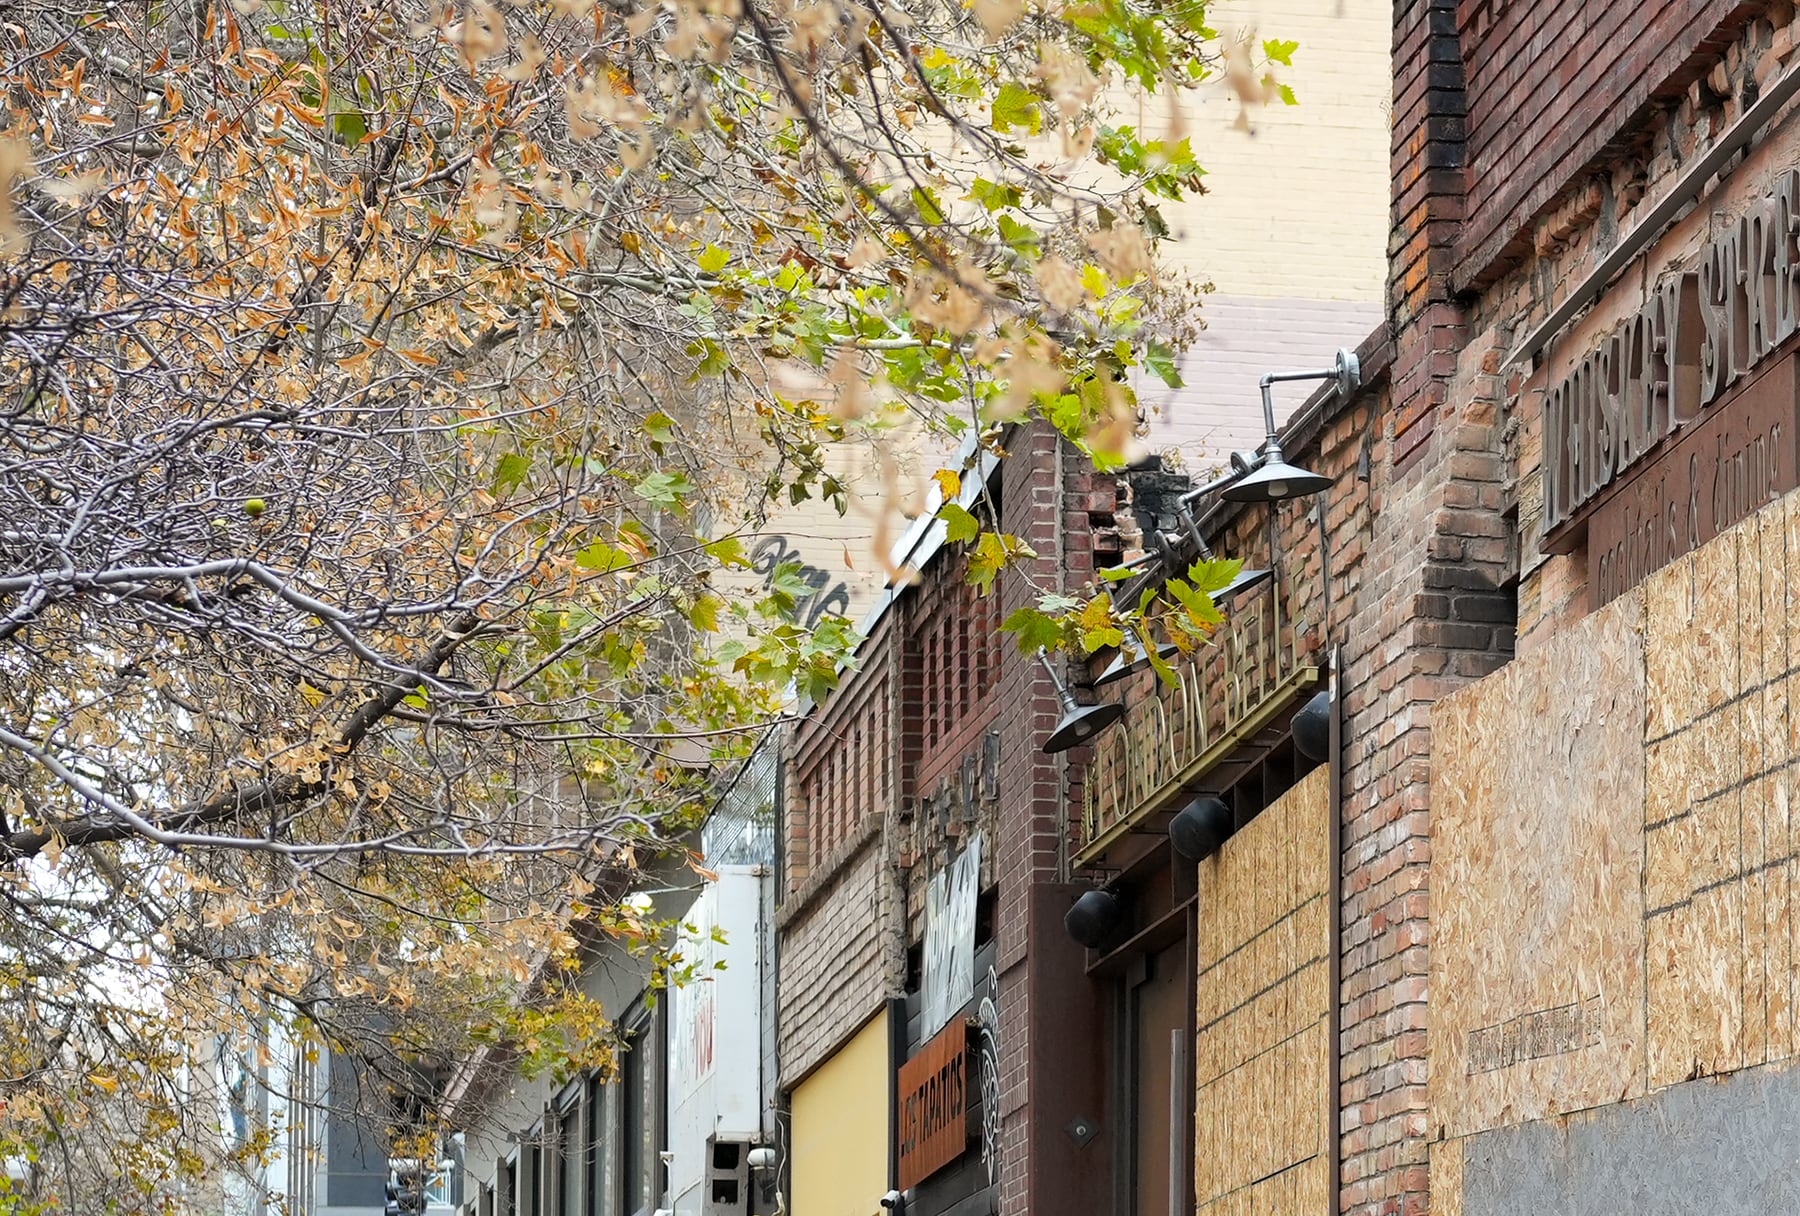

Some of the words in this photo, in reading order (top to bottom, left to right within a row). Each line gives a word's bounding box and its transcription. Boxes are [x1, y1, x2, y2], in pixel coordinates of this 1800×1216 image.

[1543, 272, 1696, 536] WHISKEY
[1686, 452, 1701, 551] &
[1713, 415, 1781, 533] dining
[901, 1091, 918, 1158] LOS
[919, 1051, 963, 1145] TAPATIOS
